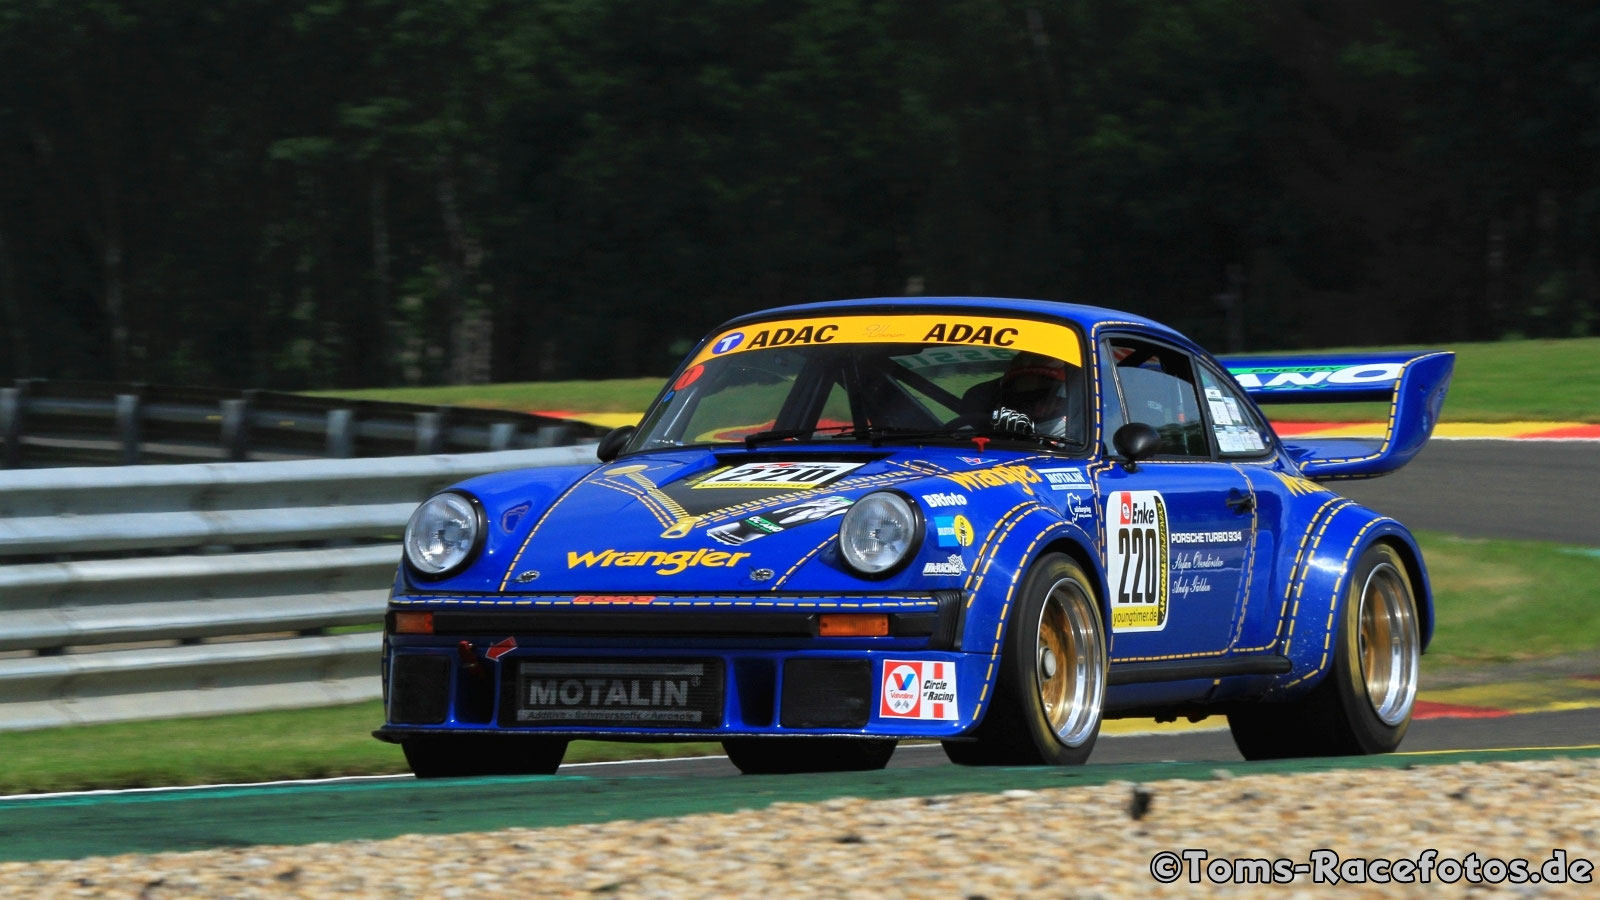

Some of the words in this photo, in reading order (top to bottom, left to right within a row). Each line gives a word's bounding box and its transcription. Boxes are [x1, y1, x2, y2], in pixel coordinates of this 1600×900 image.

[746, 324, 839, 350] ADAC
[922, 323, 1019, 347] ADAC
[716, 468, 837, 482] 220
[936, 465, 1043, 496] Wrangler
[1044, 472, 1086, 484] MOTALIN
[922, 492, 968, 508] BRfoto
[1131, 501, 1155, 525] Enke
[1171, 533, 1204, 544] PORSCHE
[1204, 532, 1229, 543] TURBO
[1228, 531, 1242, 542] 934
[567, 547, 751, 576] Wrangler
[1118, 527, 1157, 604] 220
[1171, 552, 1192, 575] Stefan
[1171, 576, 1189, 599] Andy
[1113, 608, 1158, 627] youngtimer.de
[528, 678, 690, 707] MOTALIN
[923, 680, 948, 690] Circle
[927, 691, 954, 703] Racing
